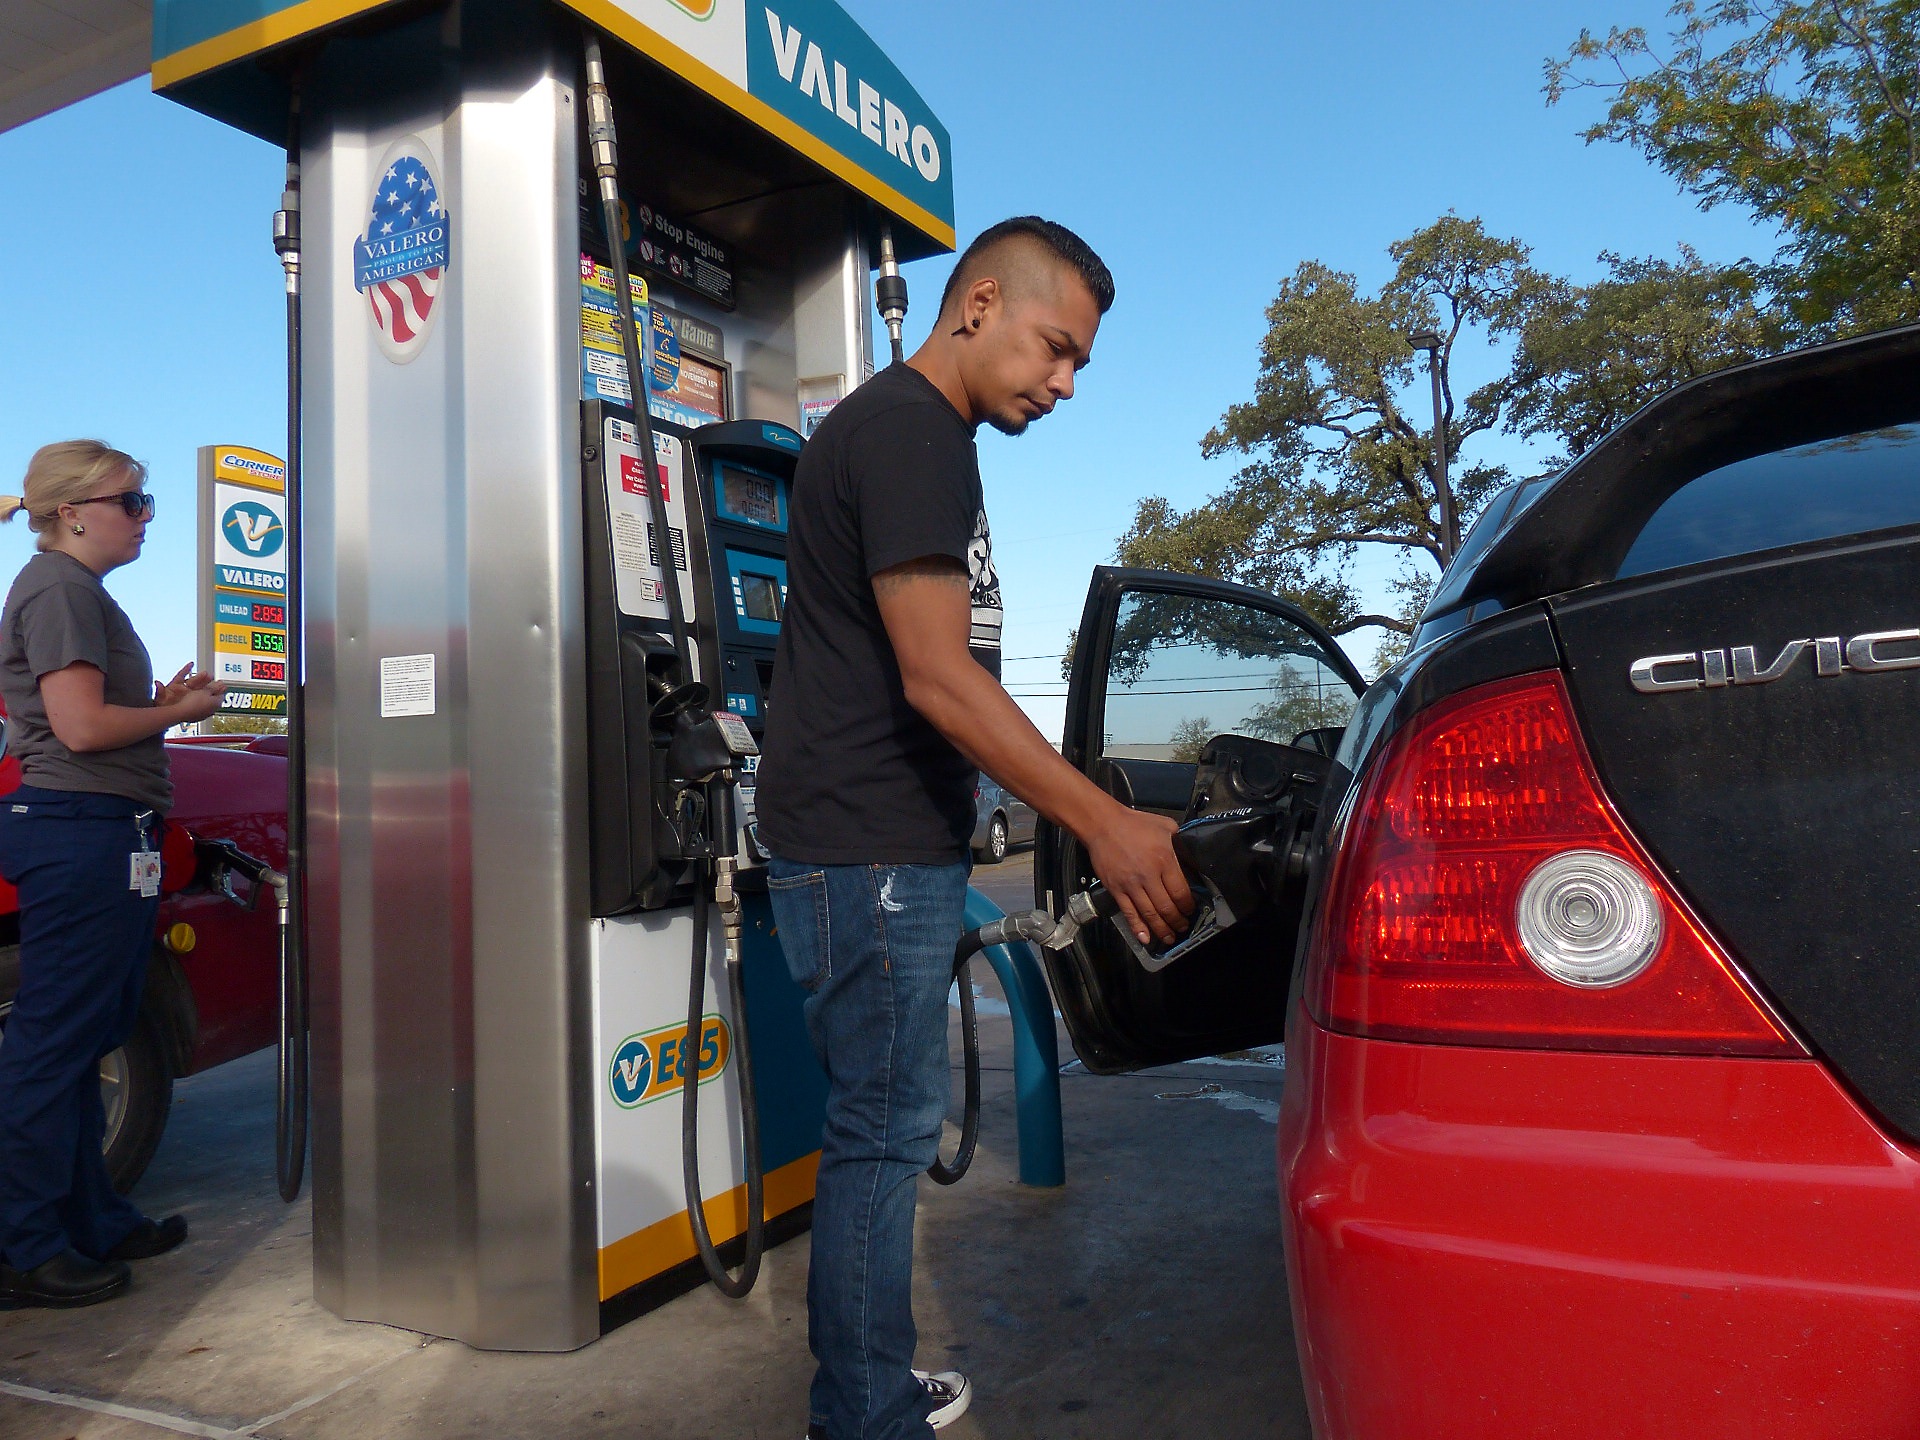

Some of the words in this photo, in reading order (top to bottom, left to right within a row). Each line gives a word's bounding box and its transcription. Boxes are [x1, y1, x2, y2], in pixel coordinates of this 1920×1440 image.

[765, 7, 940, 182] VALERO
[363, 227, 443, 259] VALERO
[655, 213, 683, 244] Stop
[686, 229, 725, 262] Engine
[361, 250, 444, 282] AMERICAN
[374, 255, 405, 267] PROUD
[423, 246, 434, 254] BE
[681, 318, 714, 349] Game
[224, 455, 284, 476] CORNER
[249, 469, 282, 480] STORE
[222, 568, 285, 590] VALERO
[219, 603, 248, 616] UNLEAD
[219, 633, 248, 645] DIESEL
[225, 663, 242, 673] E-85
[1630, 629, 1920, 694] CIVIC
[221, 692, 286, 710] SUBWAY
